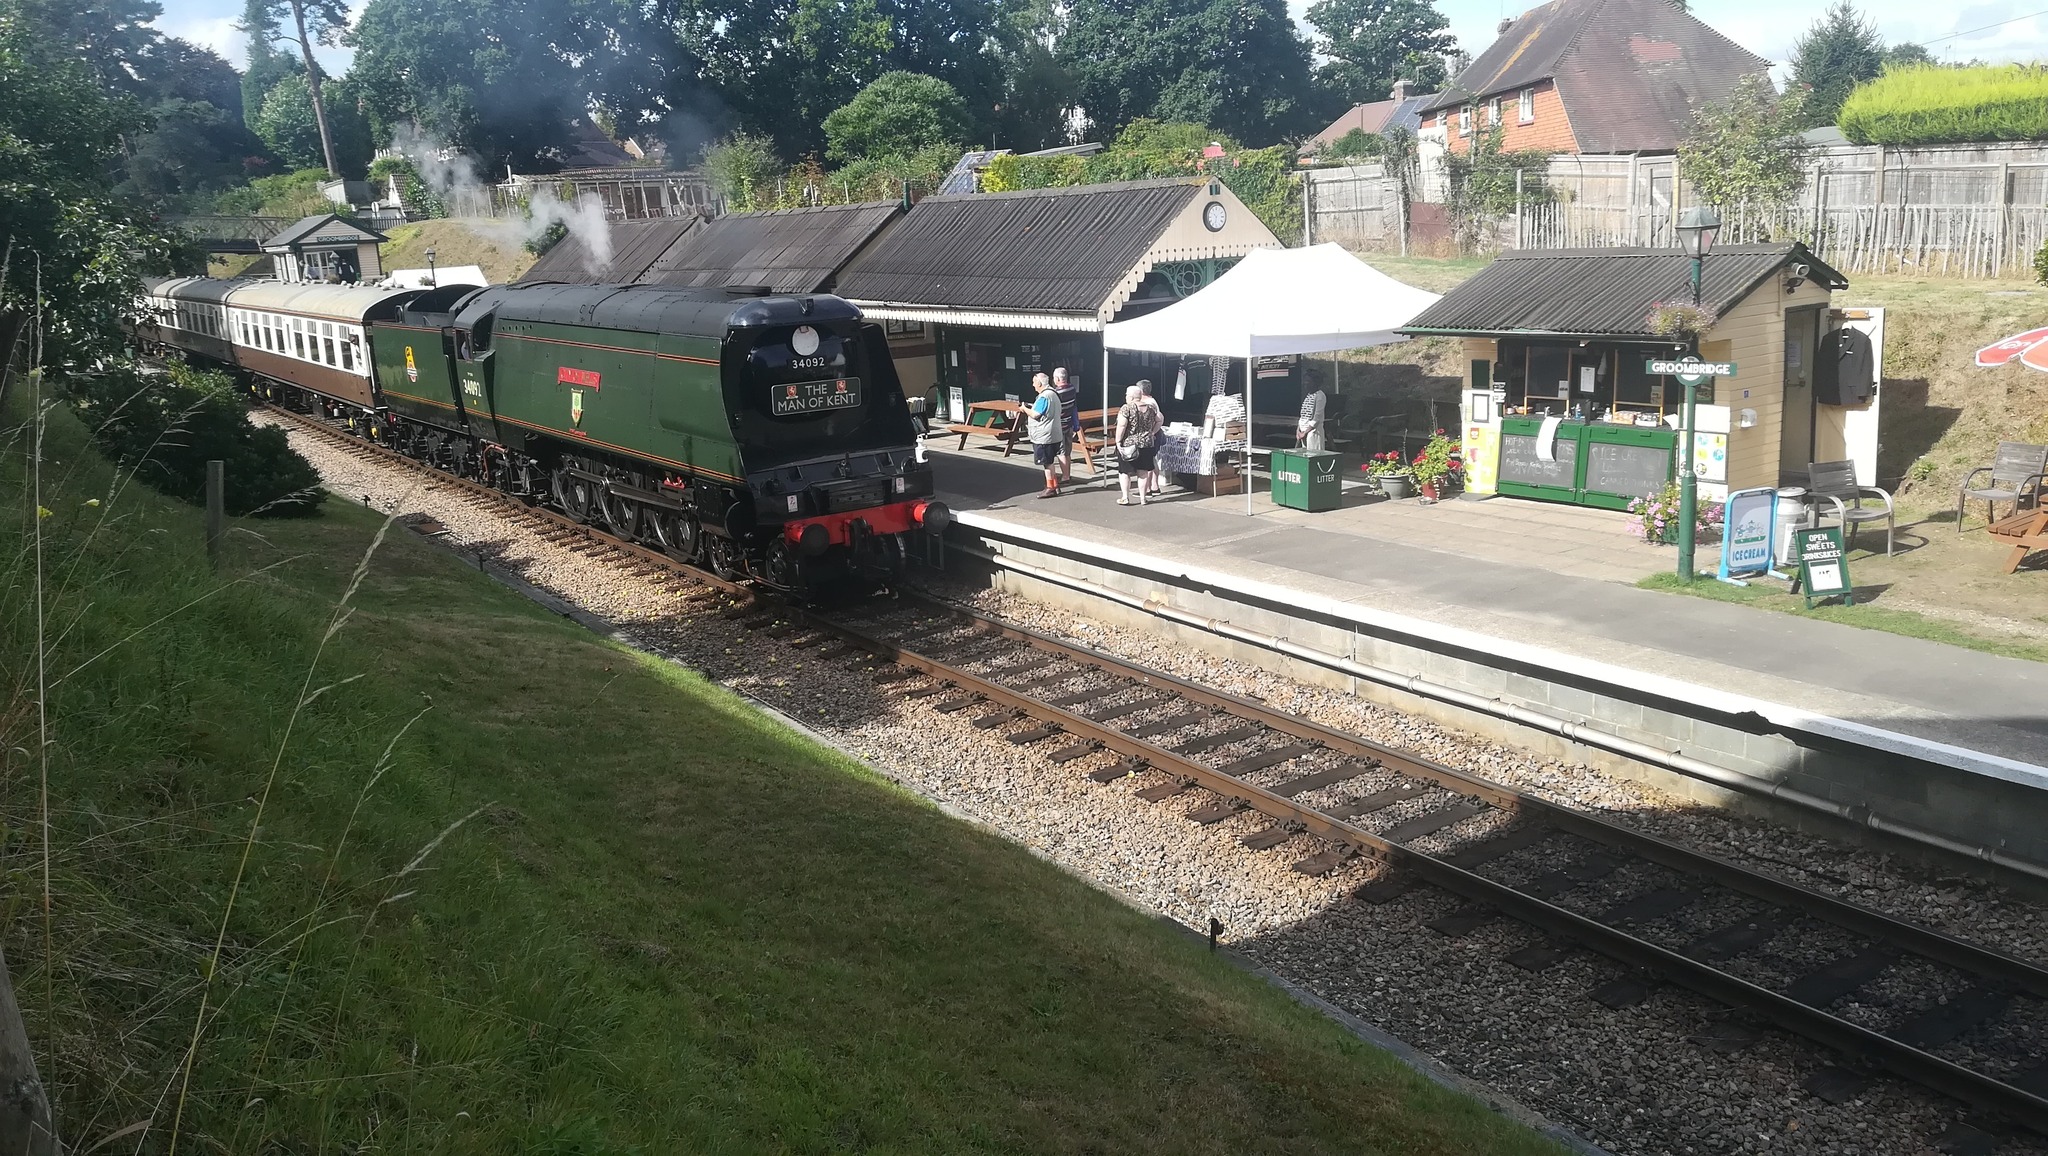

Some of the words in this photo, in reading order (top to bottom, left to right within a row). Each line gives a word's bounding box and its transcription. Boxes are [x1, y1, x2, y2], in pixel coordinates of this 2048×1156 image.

[792, 357, 825, 369] 34092
[1651, 362, 1731, 375] GROOMBRIDGE
[463, 378, 482, 397] 34092
[805, 384, 828, 396] THE
[778, 399, 806, 412] MAN
[808, 397, 824, 408] OF
[827, 393, 856, 406] KENT
[1278, 471, 1301, 484] LITTER
[1317, 474, 1335, 483] LITTER
[1809, 533, 1828, 542] OPEN
[1806, 541, 1836, 551] SWEETS
[1732, 550, 1744, 562] ICE
[1743, 548, 1766, 560] CREAM
